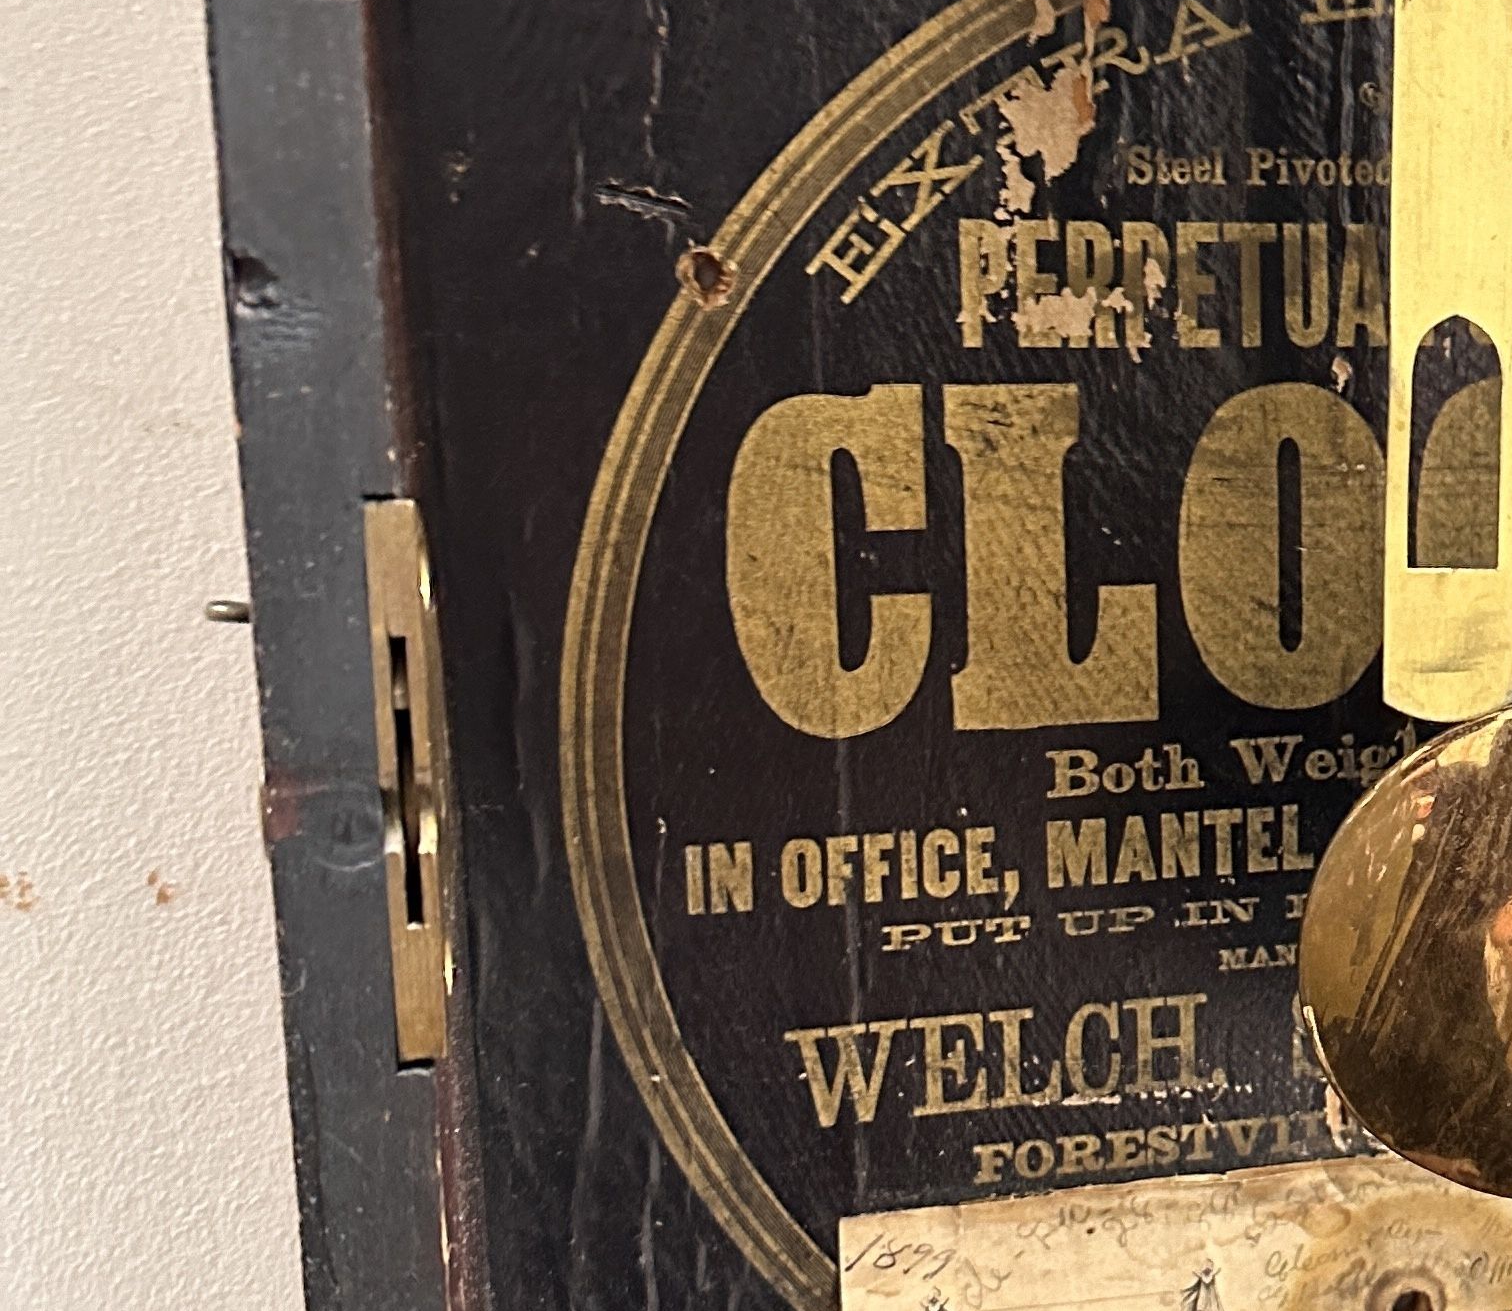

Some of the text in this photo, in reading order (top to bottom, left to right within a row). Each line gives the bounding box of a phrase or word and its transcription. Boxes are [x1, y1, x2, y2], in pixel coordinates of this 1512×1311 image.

[1127, 146, 1227, 186] Steel
[957, 219, 1392, 348] PERPETUA
[1046, 744, 1205, 799] Both
[684, 841, 754, 917] IN
[780, 826, 1021, 912] OFFICE,
[1046, 802, 1315, 890] MANTEL
[881, 914, 1032, 951] PUT
[1058, 905, 1156, 939] UP
[1183, 896, 1261, 927] IN
[784, 992, 1228, 1129] WELCH,
